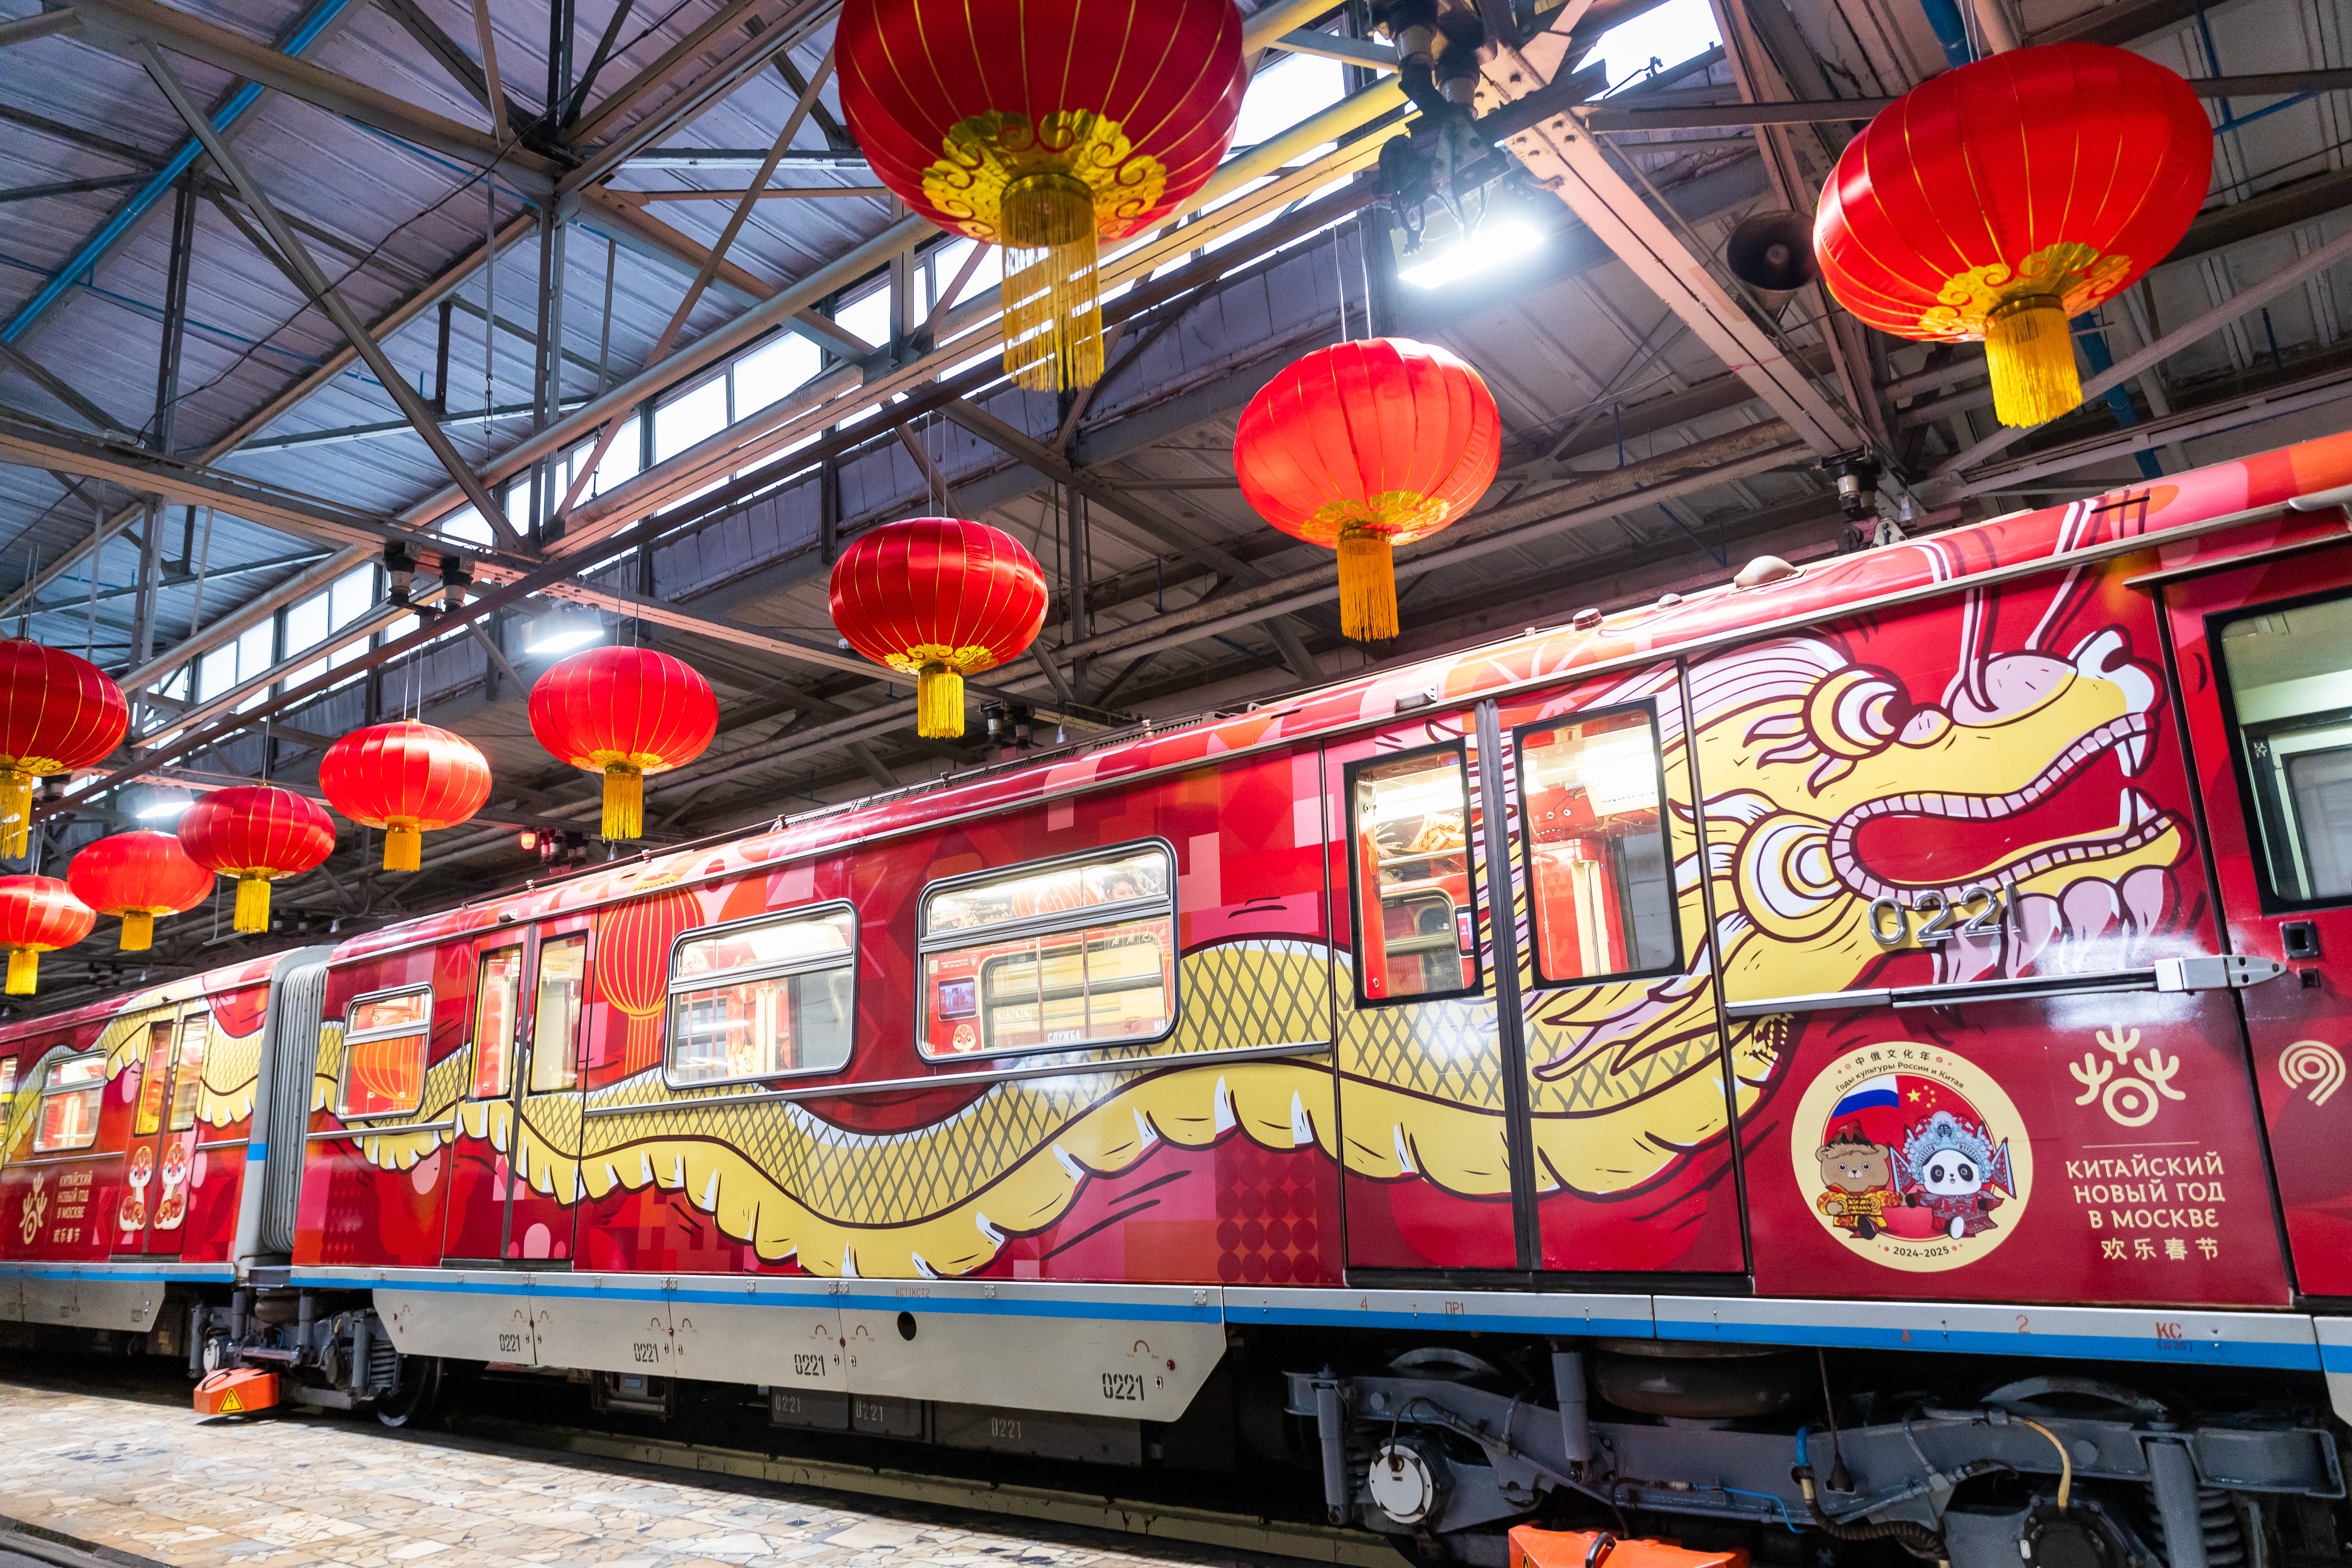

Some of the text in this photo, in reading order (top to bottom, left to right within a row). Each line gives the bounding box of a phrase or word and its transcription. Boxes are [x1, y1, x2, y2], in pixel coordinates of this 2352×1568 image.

[1868, 881, 2021, 945] 0221
[1047, 1030, 1080, 1043] СЛУЖБА
[1855, 1048, 1930, 1066] 中俄文化年
[1836, 1075, 1855, 1093] Годы
[1855, 1063, 1895, 1080] культуры
[1898, 1062, 1929, 1073] России
[1939, 1070, 1964, 1089] Китая
[2066, 1151, 2224, 1178] КИТАЙСКИЙ
[2073, 1179, 2225, 1204] НОВЫЙ ГОД
[2088, 1208, 2218, 1229] В МОСКВЕ
[1893, 1246, 1949, 1257] 2024-2025
[2101, 1237, 2217, 1261] 欢乐春节
[1361, 1296, 1368, 1311] 4
[1445, 1301, 1464, 1314] ПР1
[2016, 1314, 2030, 1334] 2
[2156, 1322, 2182, 1339] КС
[500, 1334, 521, 1352] 0221
[633, 1343, 659, 1363] 0221
[794, 1353, 825, 1377] 0221
[1102, 1373, 1144, 1401] 0221
[776, 1394, 801, 1413] 0221
[856, 1400, 883, 1422] 0221
[992, 1418, 1021, 1439] 0221
